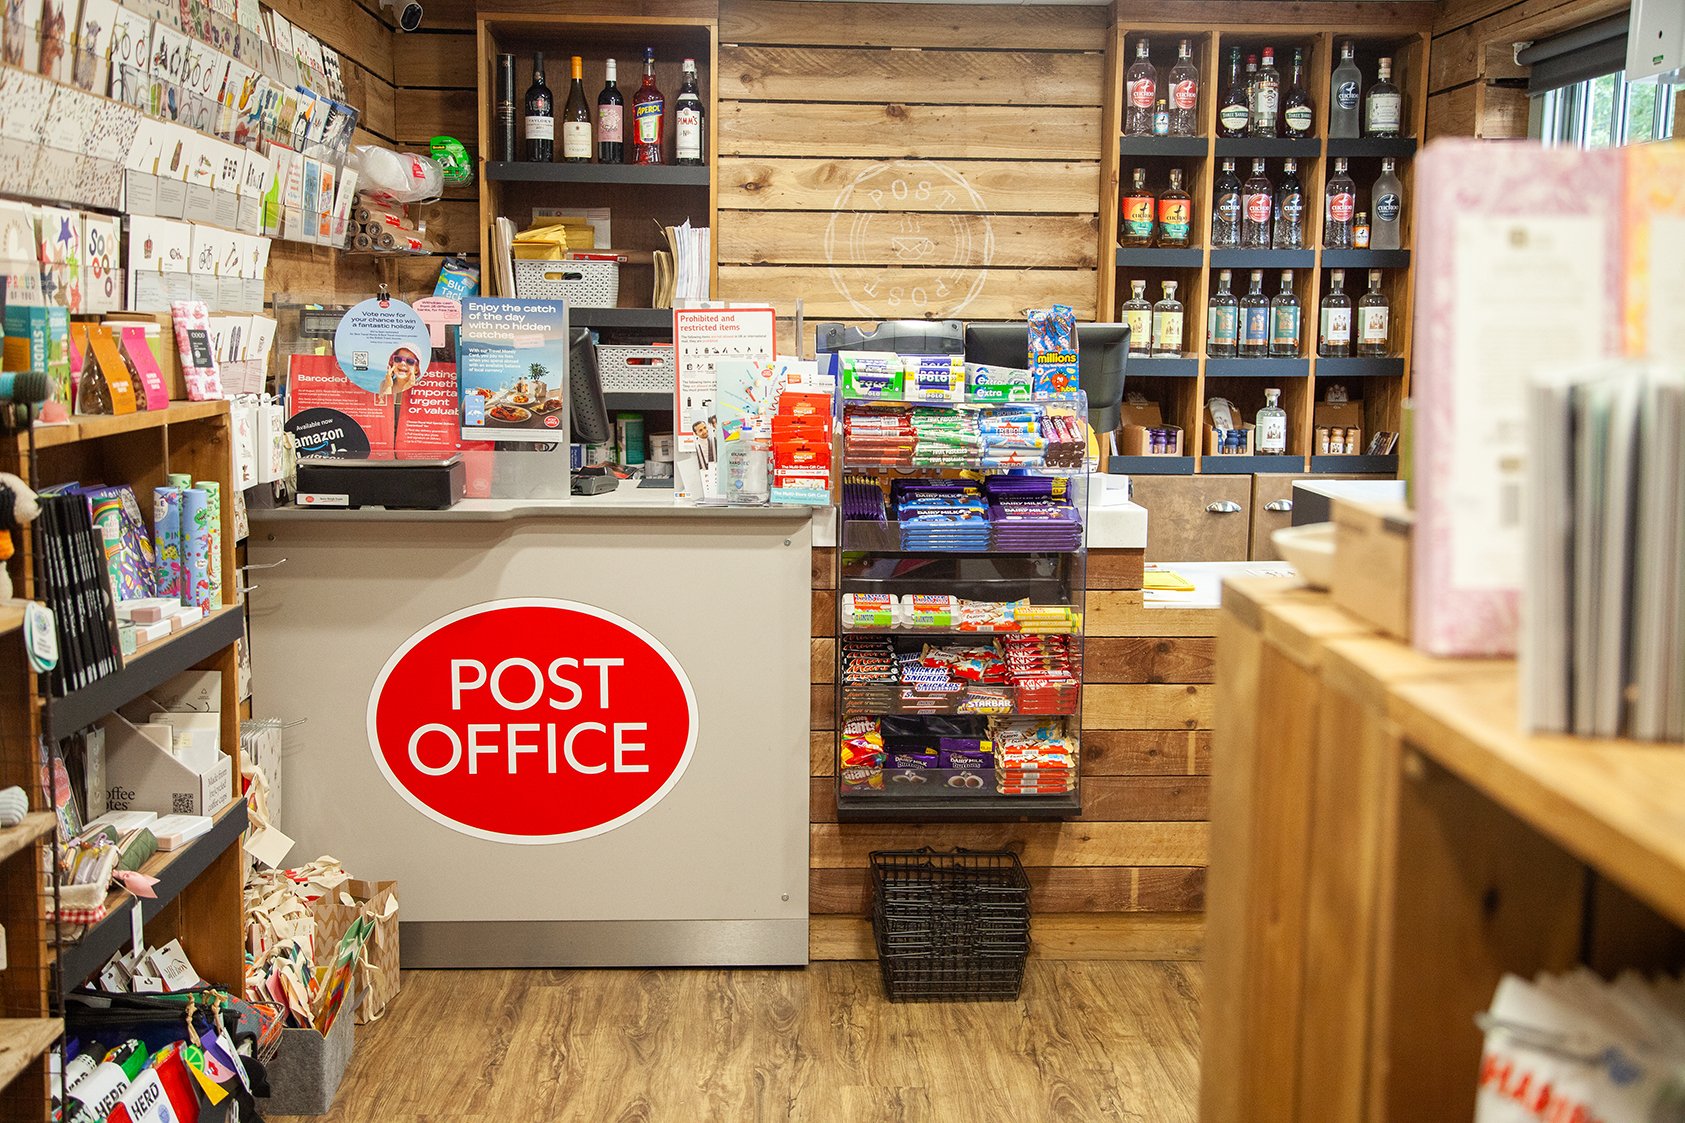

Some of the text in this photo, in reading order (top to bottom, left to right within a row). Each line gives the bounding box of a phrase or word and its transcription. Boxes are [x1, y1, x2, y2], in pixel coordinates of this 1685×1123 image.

[637, 105, 660, 115] APEROL
[677, 116, 698, 125] PIMM'S
[868, 179, 957, 209] POST
[7, 275, 36, 289] PROUD
[447, 279, 466, 292] Blu
[10, 292, 17, 300] OF
[468, 303, 556, 313] Enjoy the catch
[468, 312, 526, 323] of the day
[680, 314, 719, 322] Prohibited
[512, 322, 551, 331] hidden
[719, 323, 740, 331] items
[1037, 352, 1077, 364] millions
[297, 374, 347, 383] Barcoded
[423, 370, 457, 380] osting
[920, 372, 948, 382] POLO
[976, 388, 1003, 398] extra
[409, 398, 450, 407] urgent
[296, 418, 334, 431] Available now
[995, 427, 1024, 435] TREBOR
[295, 427, 345, 448] amazon
[902, 667, 947, 675] SNICKERS
[905, 674, 949, 682] SNICKERS
[451, 657, 624, 711] POST
[916, 683, 960, 691] SNICKERS
[968, 699, 1012, 708] STARBAR
[408, 721, 649, 776] OFFICE
[106, 786, 136, 800] offee
[106, 801, 129, 811] otes
[95, 1081, 128, 1119] HERD
[131, 1081, 160, 1121] HERD
